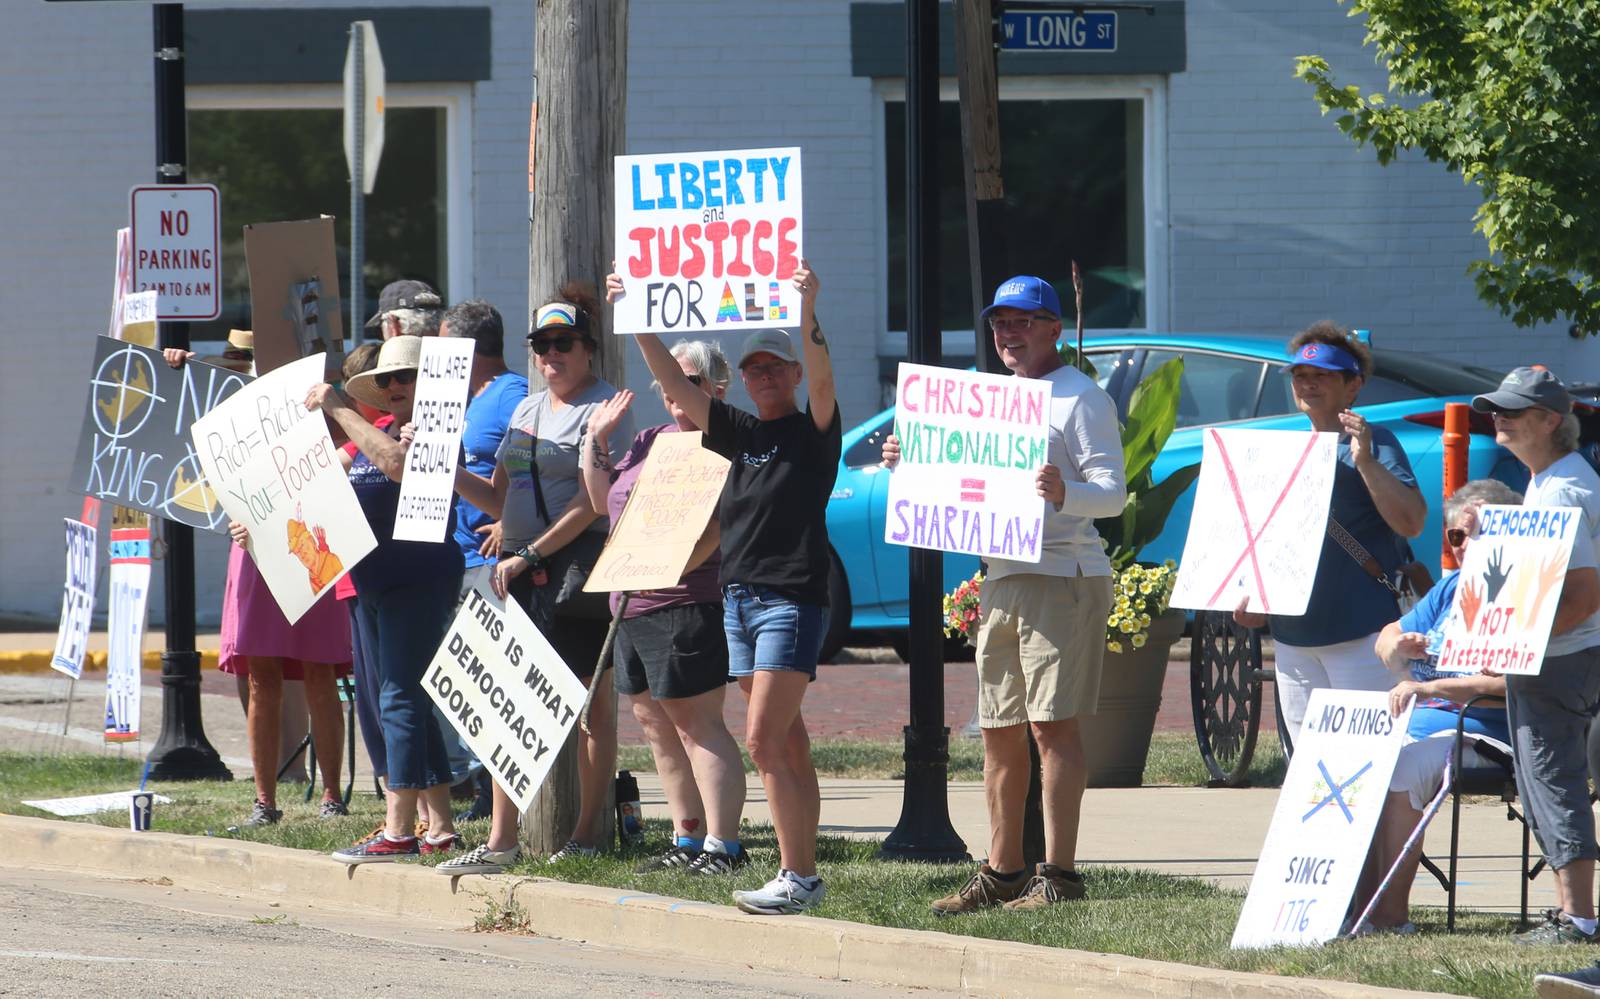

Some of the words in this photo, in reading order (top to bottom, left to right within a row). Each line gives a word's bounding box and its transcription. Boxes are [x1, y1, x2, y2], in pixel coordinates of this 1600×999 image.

[1004, 23, 1015, 39] W
[1025, 16, 1087, 46] LONG
[1097, 23, 1112, 39] ST
[631, 155, 791, 211] LIBERTY
[160, 209, 189, 236] NO
[703, 204, 724, 223] and
[139, 249, 212, 270] PARKING
[628, 217, 799, 280] JUSTICE
[169, 282, 183, 296] TO
[185, 282, 192, 296] 6
[195, 282, 211, 296] AM
[646, 279, 707, 328] FOR
[716, 280, 788, 323] ALL
[421, 355, 442, 379] ALL
[444, 356, 468, 380] ARE
[902, 373, 1044, 426] CHRISTIAN
[413, 400, 462, 433] CREATED
[410, 442, 451, 475] EQUAL
[657, 446, 697, 464] GIVE
[895, 418, 1046, 471] NATIONALISM
[653, 468, 682, 485] ME
[891, 499, 983, 553] SHARIA
[989, 512, 1041, 556] LAW
[1480, 509, 1572, 540] DEMOCRACY
[1478, 607, 1515, 636] NOT
[466, 588, 505, 642] THIS
[504, 636, 524, 667] IS
[523, 663, 575, 727] WHAT
[447, 632, 549, 763] DEMOCRACY
[430, 665, 484, 738] LOOKS
[489, 743, 531, 799] LIKE
[1317, 704, 1346, 734] NO
[1347, 707, 1394, 737] KINGS
[1285, 856, 1335, 886] SINCE
[1272, 898, 1318, 932] 1776
